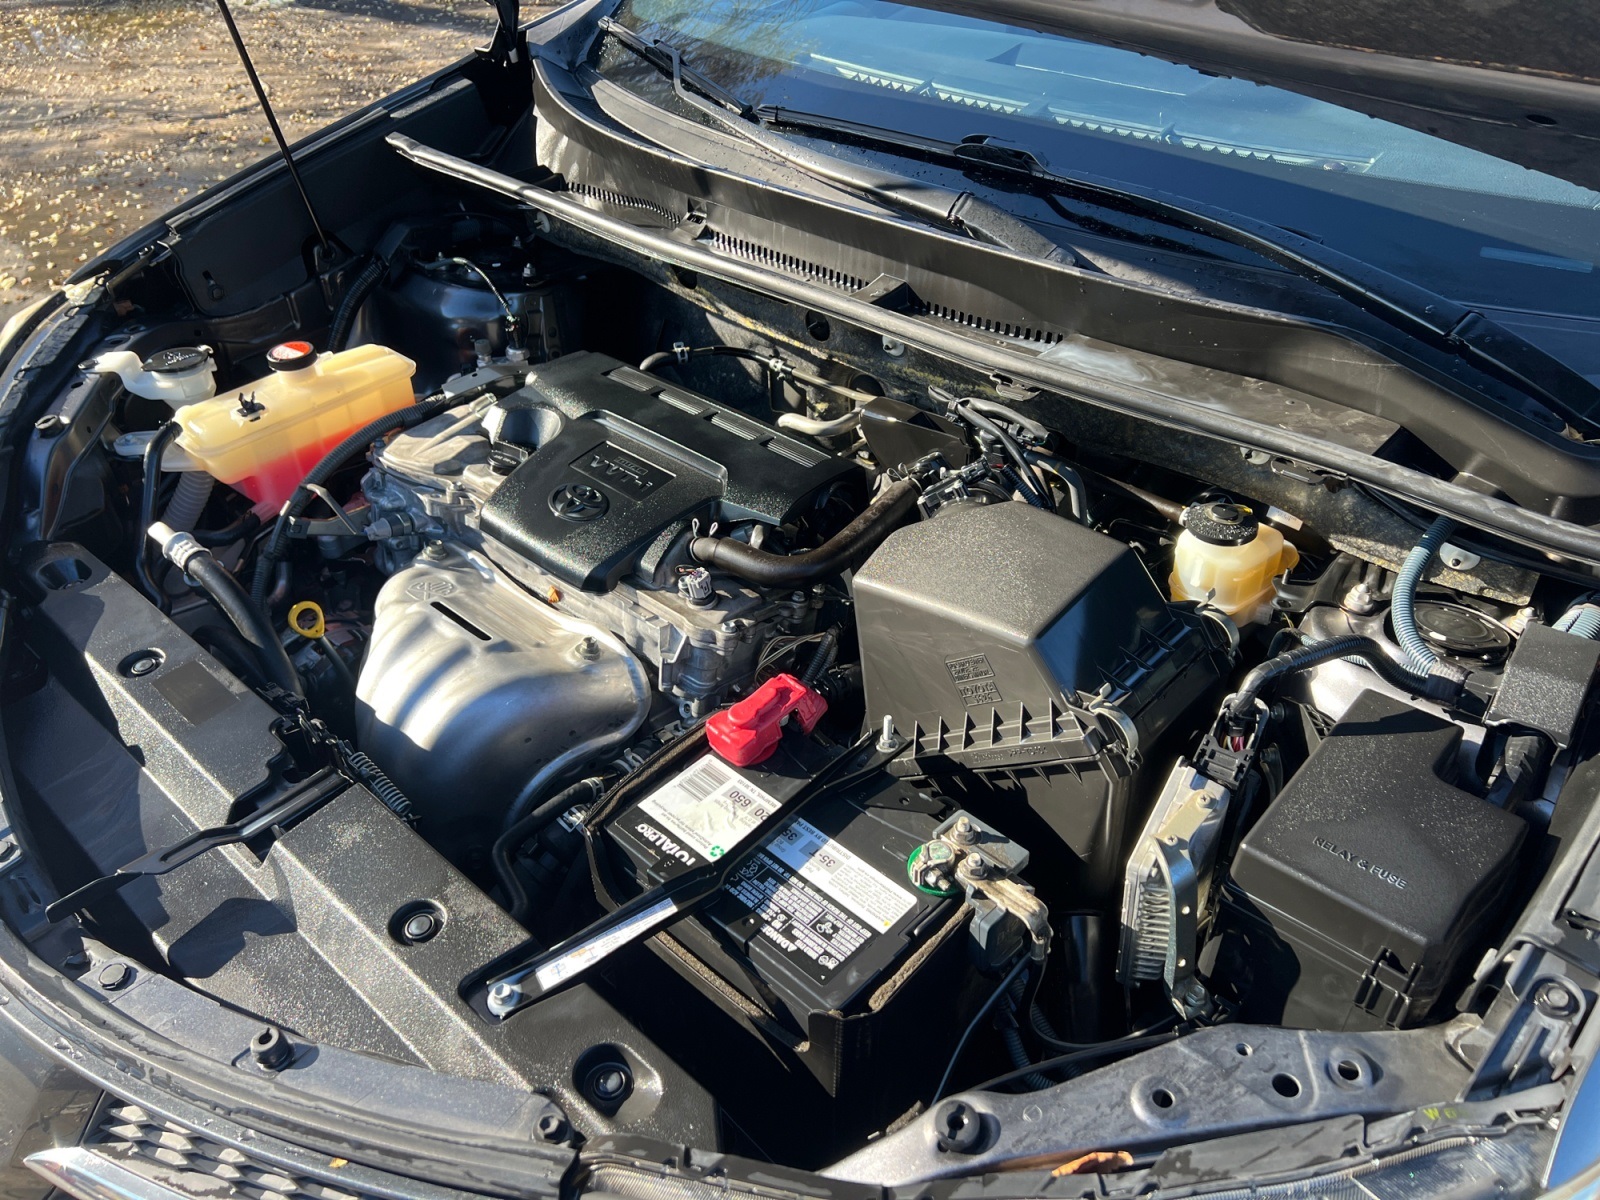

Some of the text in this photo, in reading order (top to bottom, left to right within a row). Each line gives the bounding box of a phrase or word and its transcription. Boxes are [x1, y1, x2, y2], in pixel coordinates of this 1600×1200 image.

[728, 790, 752, 808] 650
[780, 827, 836, 867] 35-T 35
[1312, 836, 1408, 889] RELAY & FUSE
